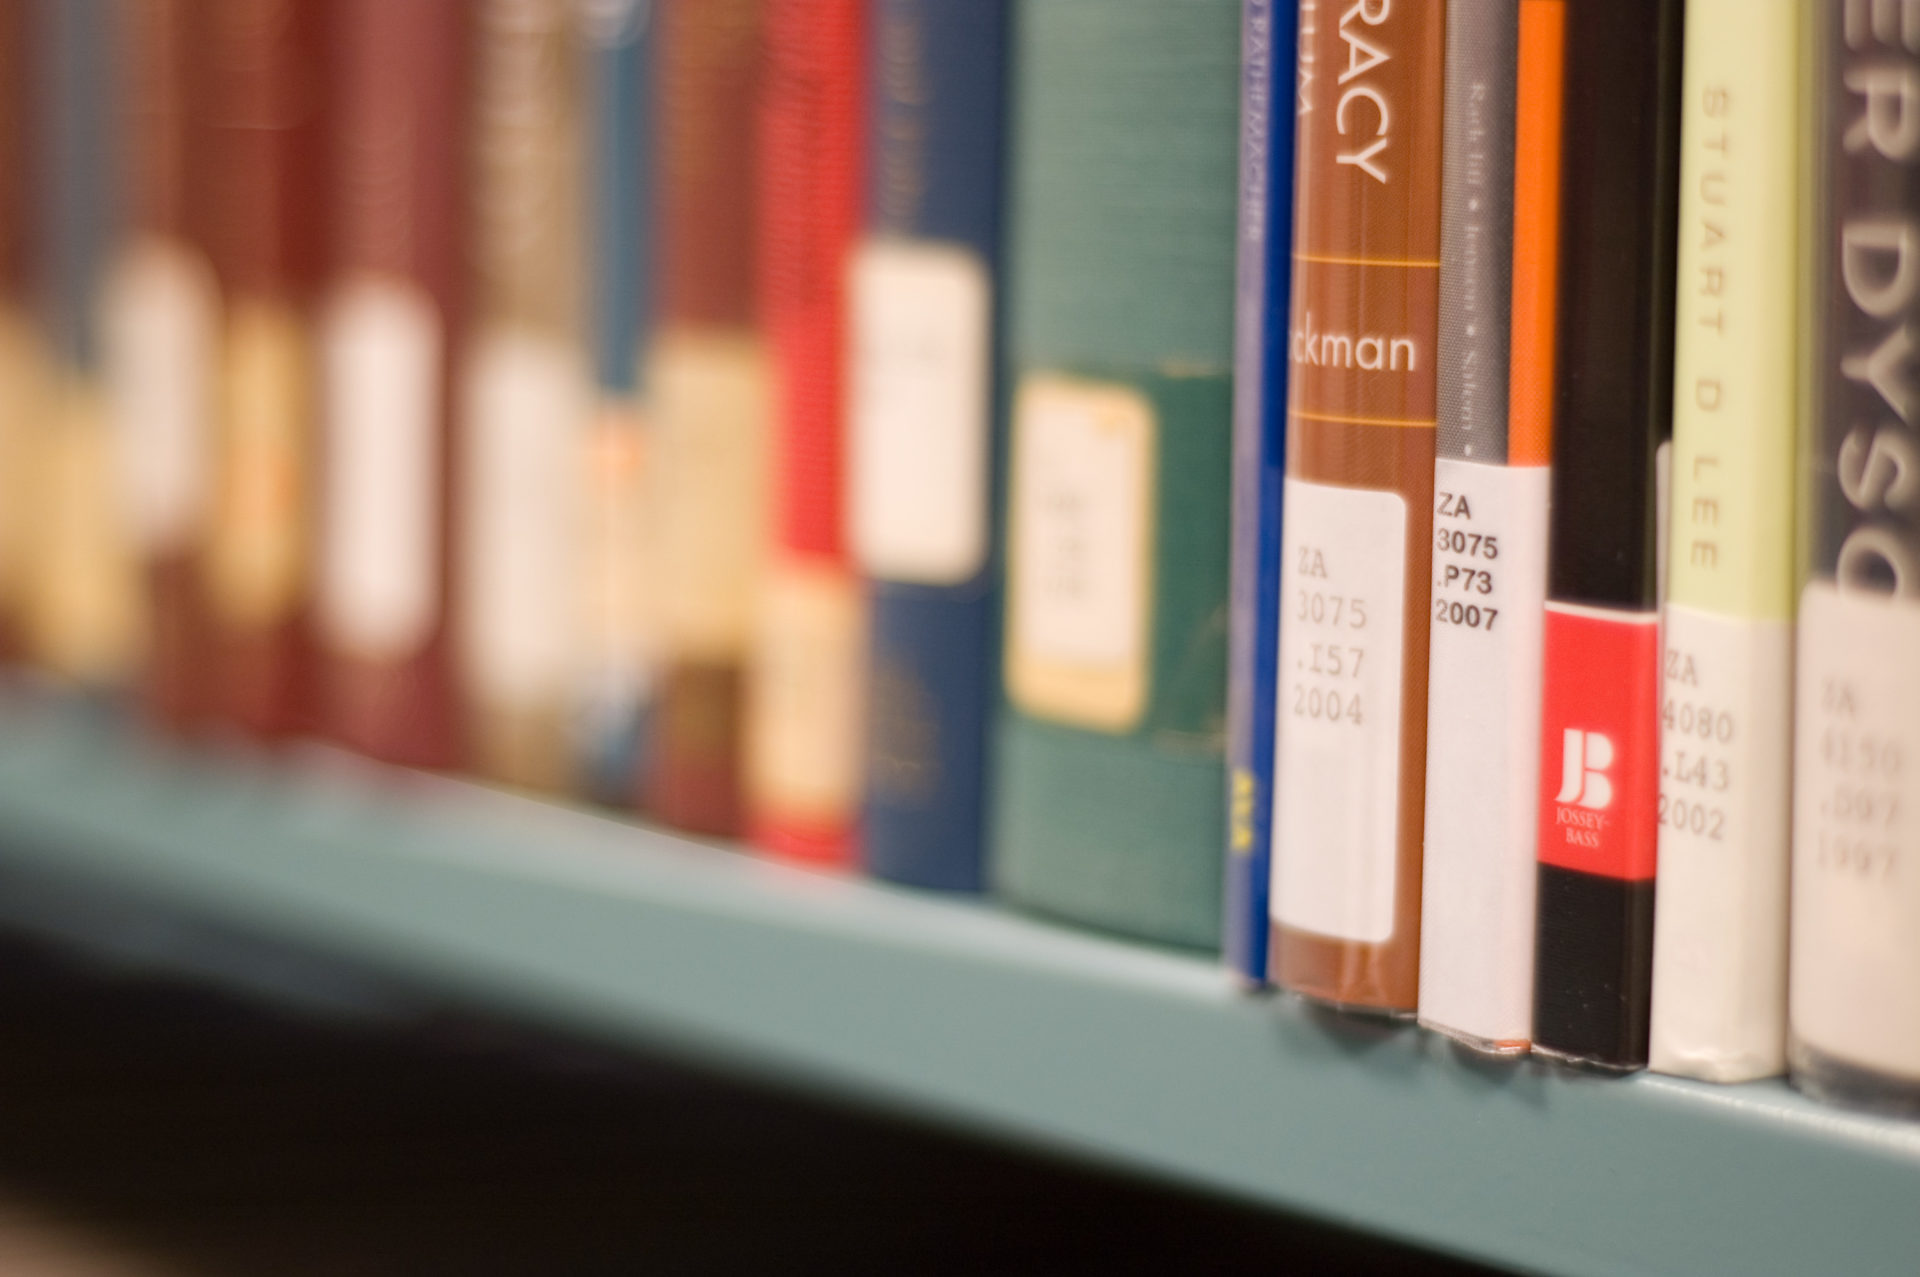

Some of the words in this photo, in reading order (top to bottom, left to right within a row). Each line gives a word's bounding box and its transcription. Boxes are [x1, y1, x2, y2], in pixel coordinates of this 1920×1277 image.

[1699, 85, 1728, 336] STUART
[1695, 377, 1723, 413] D
[1437, 491, 1472, 519] ZA
[1690, 453, 1720, 570] LEE
[1297, 546, 1329, 580] ZA
[1436, 528, 1499, 560] 3075
[1436, 565, 1494, 594] .P73
[1297, 591, 1368, 629] 3075
[1435, 600, 1499, 631] 2007
[1665, 649, 1699, 687] ZA
[1294, 684, 1364, 726] 2004
[1661, 699, 1735, 744] 4080
[1554, 728, 1613, 810] JB
[1662, 750, 1730, 792] .L43
[1556, 806, 1611, 831] JOSSEY-
[1657, 793, 1726, 841] 2002
[1565, 827, 1600, 849] BASS
